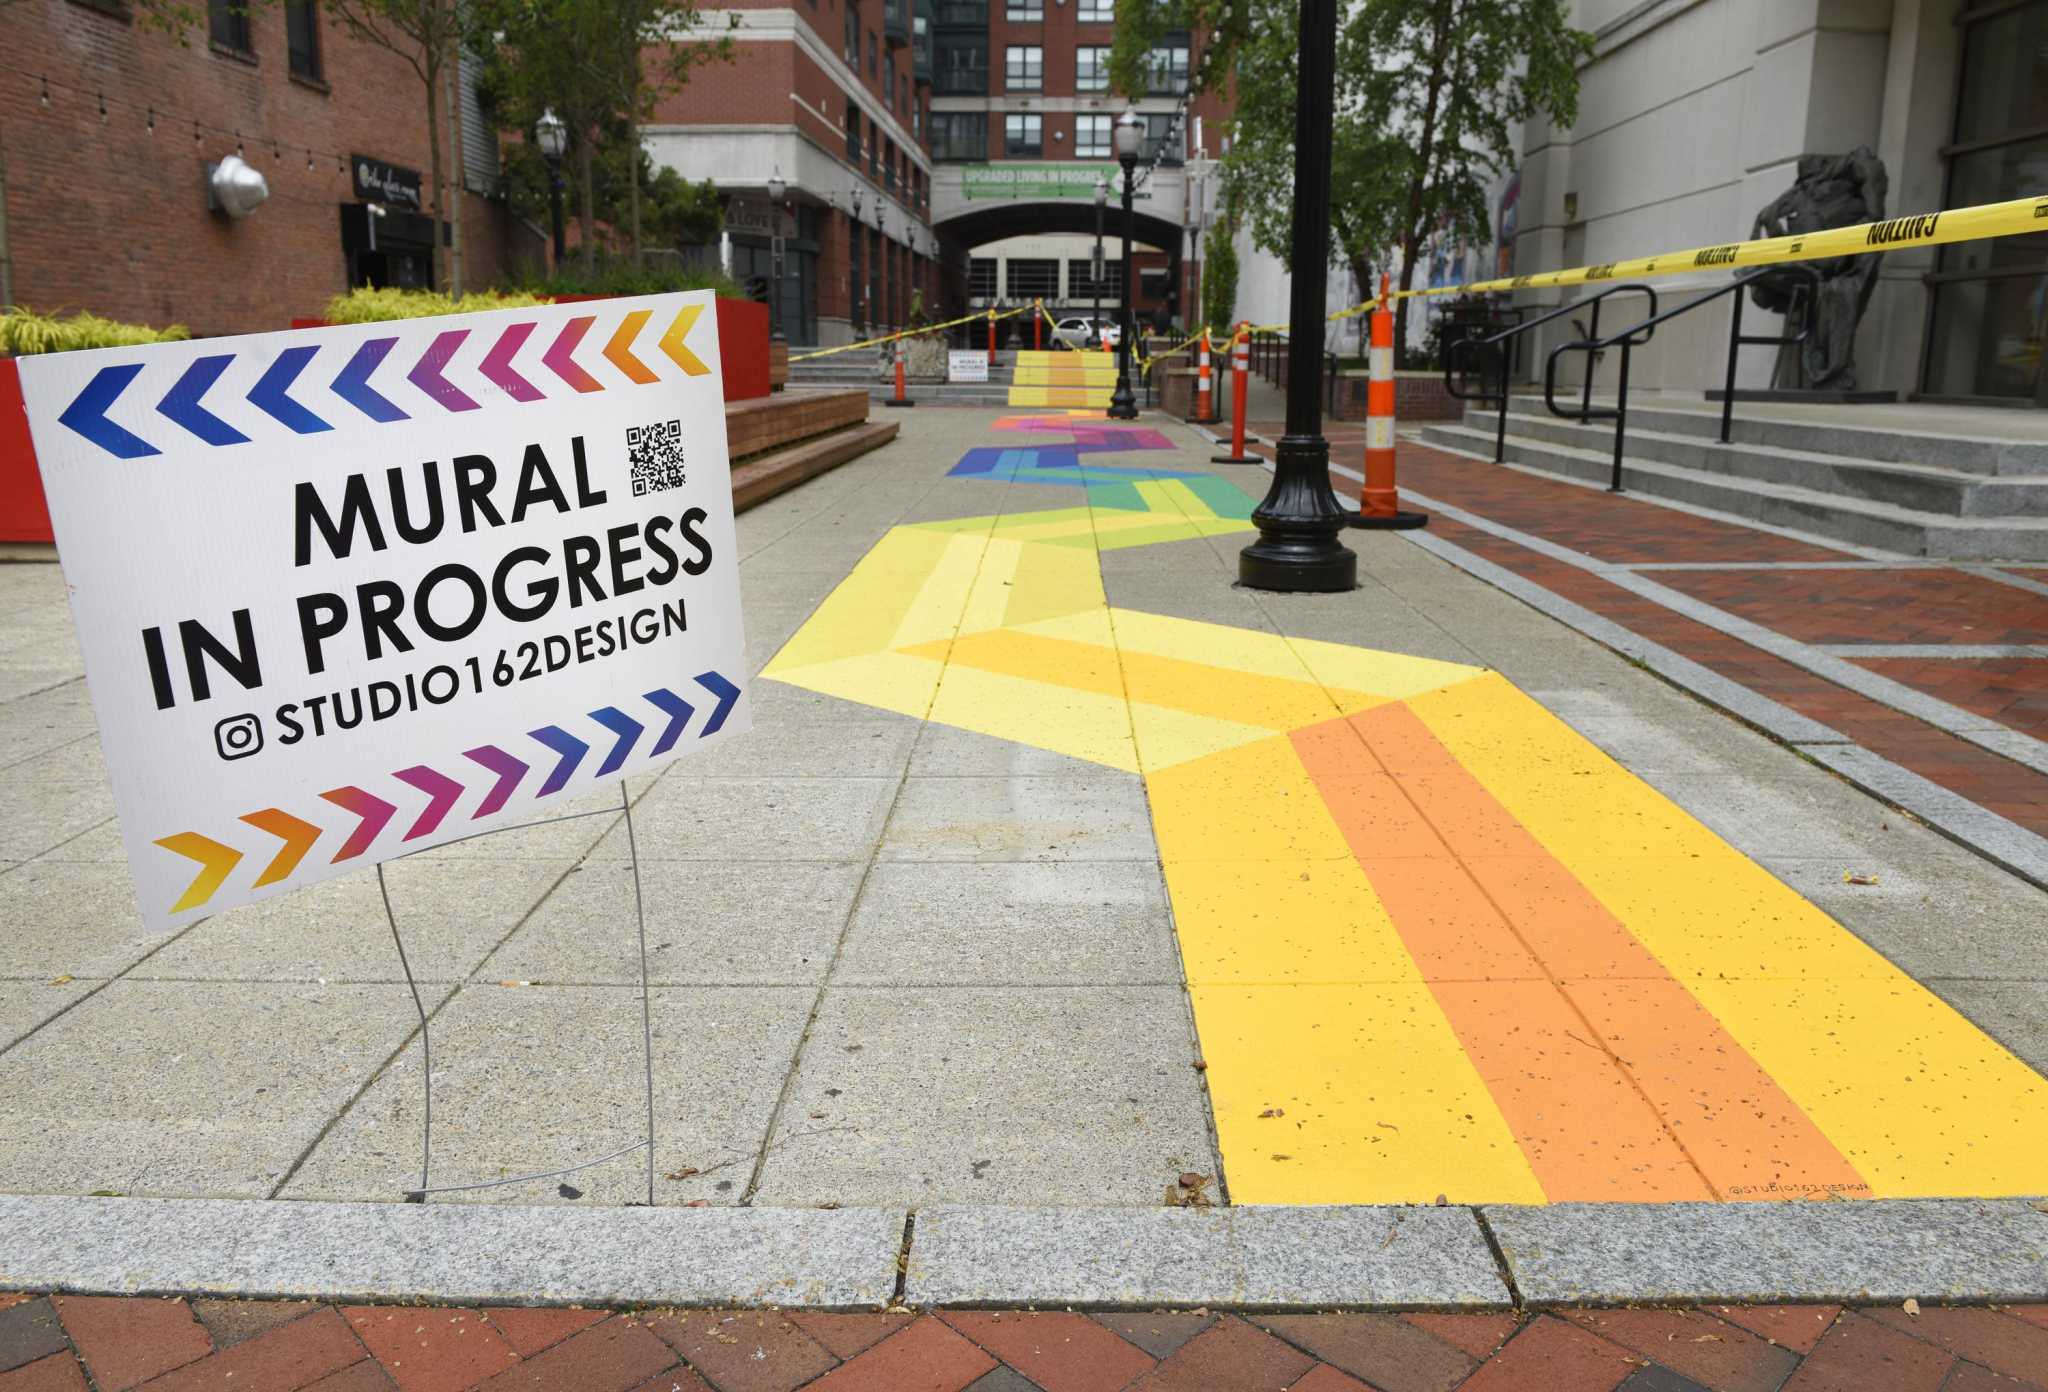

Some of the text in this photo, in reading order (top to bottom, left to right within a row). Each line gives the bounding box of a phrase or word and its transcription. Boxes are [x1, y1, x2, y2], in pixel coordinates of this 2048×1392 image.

[1694, 245, 1740, 266] CAUTION
[1867, 214, 1940, 245] CAUTION
[295, 436, 607, 566] MURAL
[142, 508, 713, 711] IN PROGRESS
[276, 599, 687, 745] STUDIO162DESIGN
